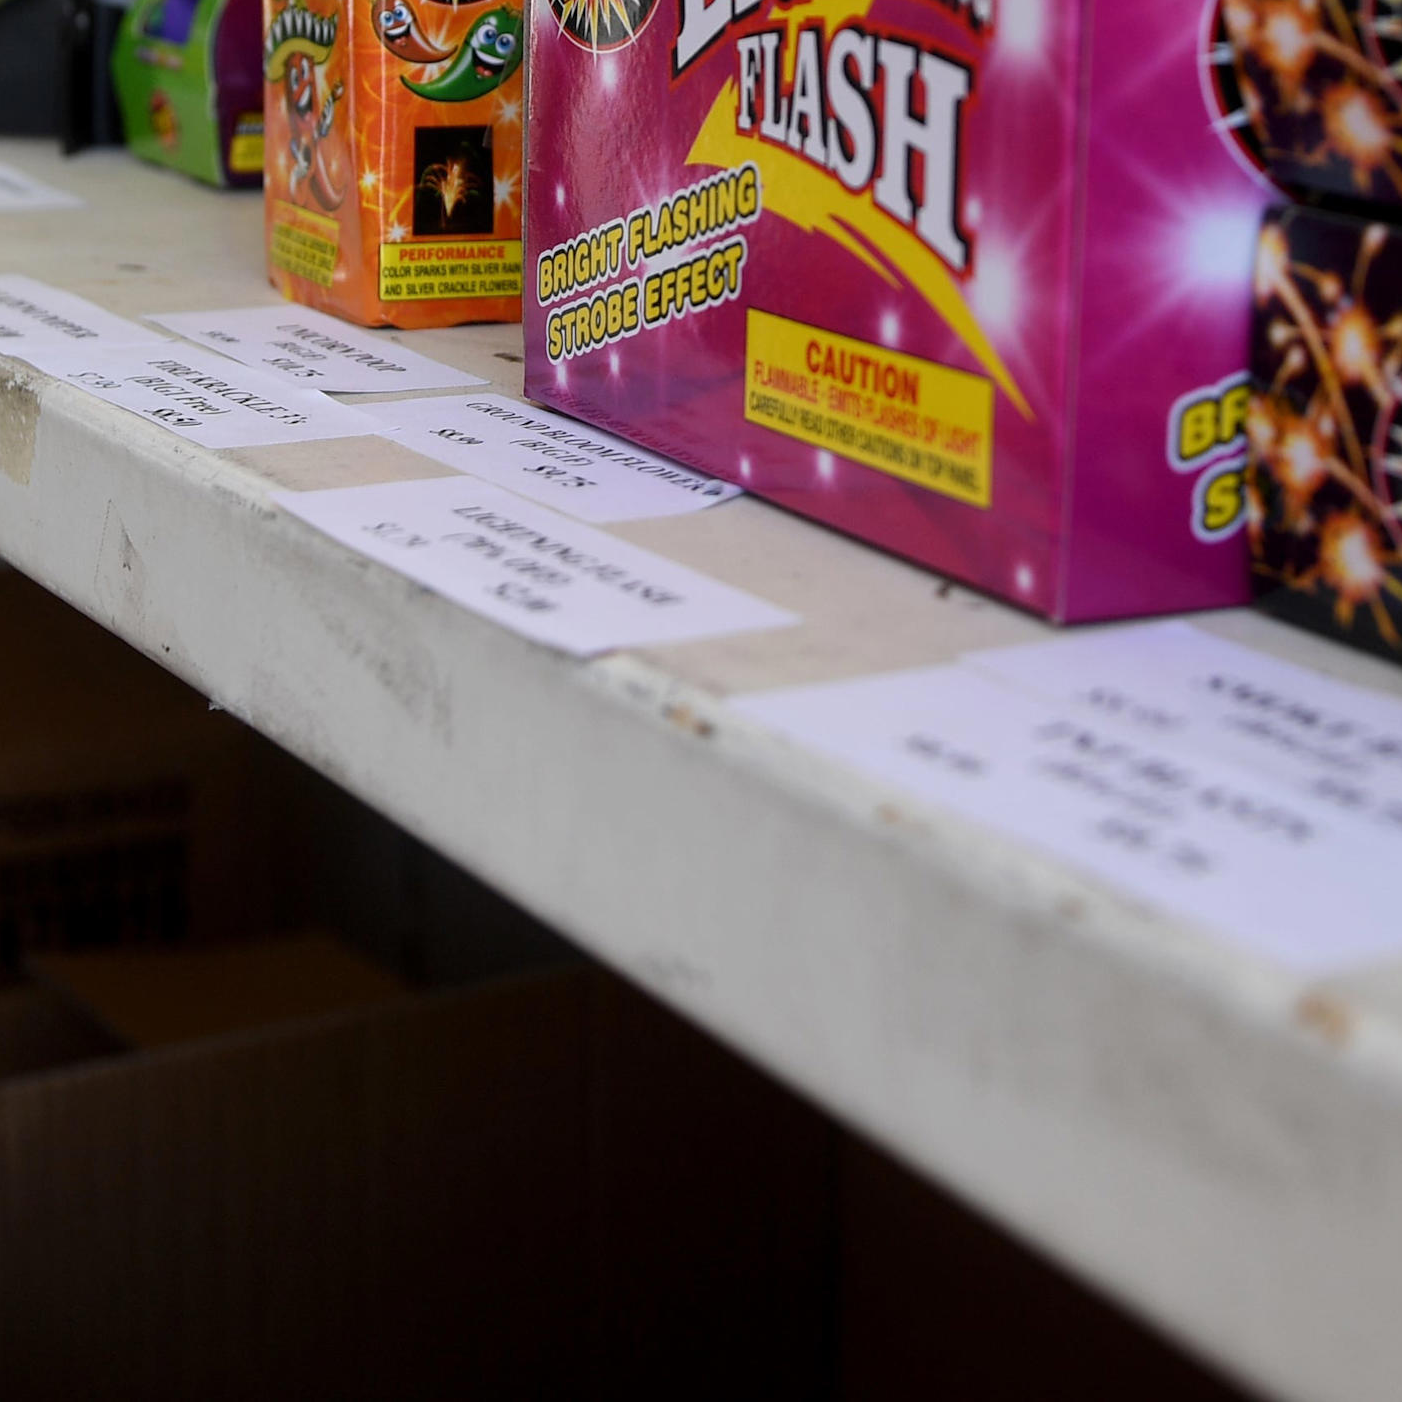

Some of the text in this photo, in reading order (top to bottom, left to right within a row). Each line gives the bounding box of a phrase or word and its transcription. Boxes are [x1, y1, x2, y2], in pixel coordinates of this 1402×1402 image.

[735, 26, 972, 271] FLASH
[399, 245, 505, 262] PERFORMANCE
[538, 168, 758, 297] BRIGHT FLASHING
[382, 265, 412, 278] COLOR
[413, 263, 447, 277] SPARKS
[449, 262, 469, 276] WITH
[471, 261, 500, 275] SILVER
[384, 283, 402, 296] AND
[406, 282, 434, 296] SILVER
[438, 280, 476, 294] CRACKLE
[546, 245, 743, 362] STROBE EFFECT
[147, 359, 197, 379] FIRE
[191, 376, 282, 414] KRACKLE
[805, 338, 921, 407] CAUTION
[465, 400, 549, 436] GROUND
[545, 430, 618, 462] BLOOM
